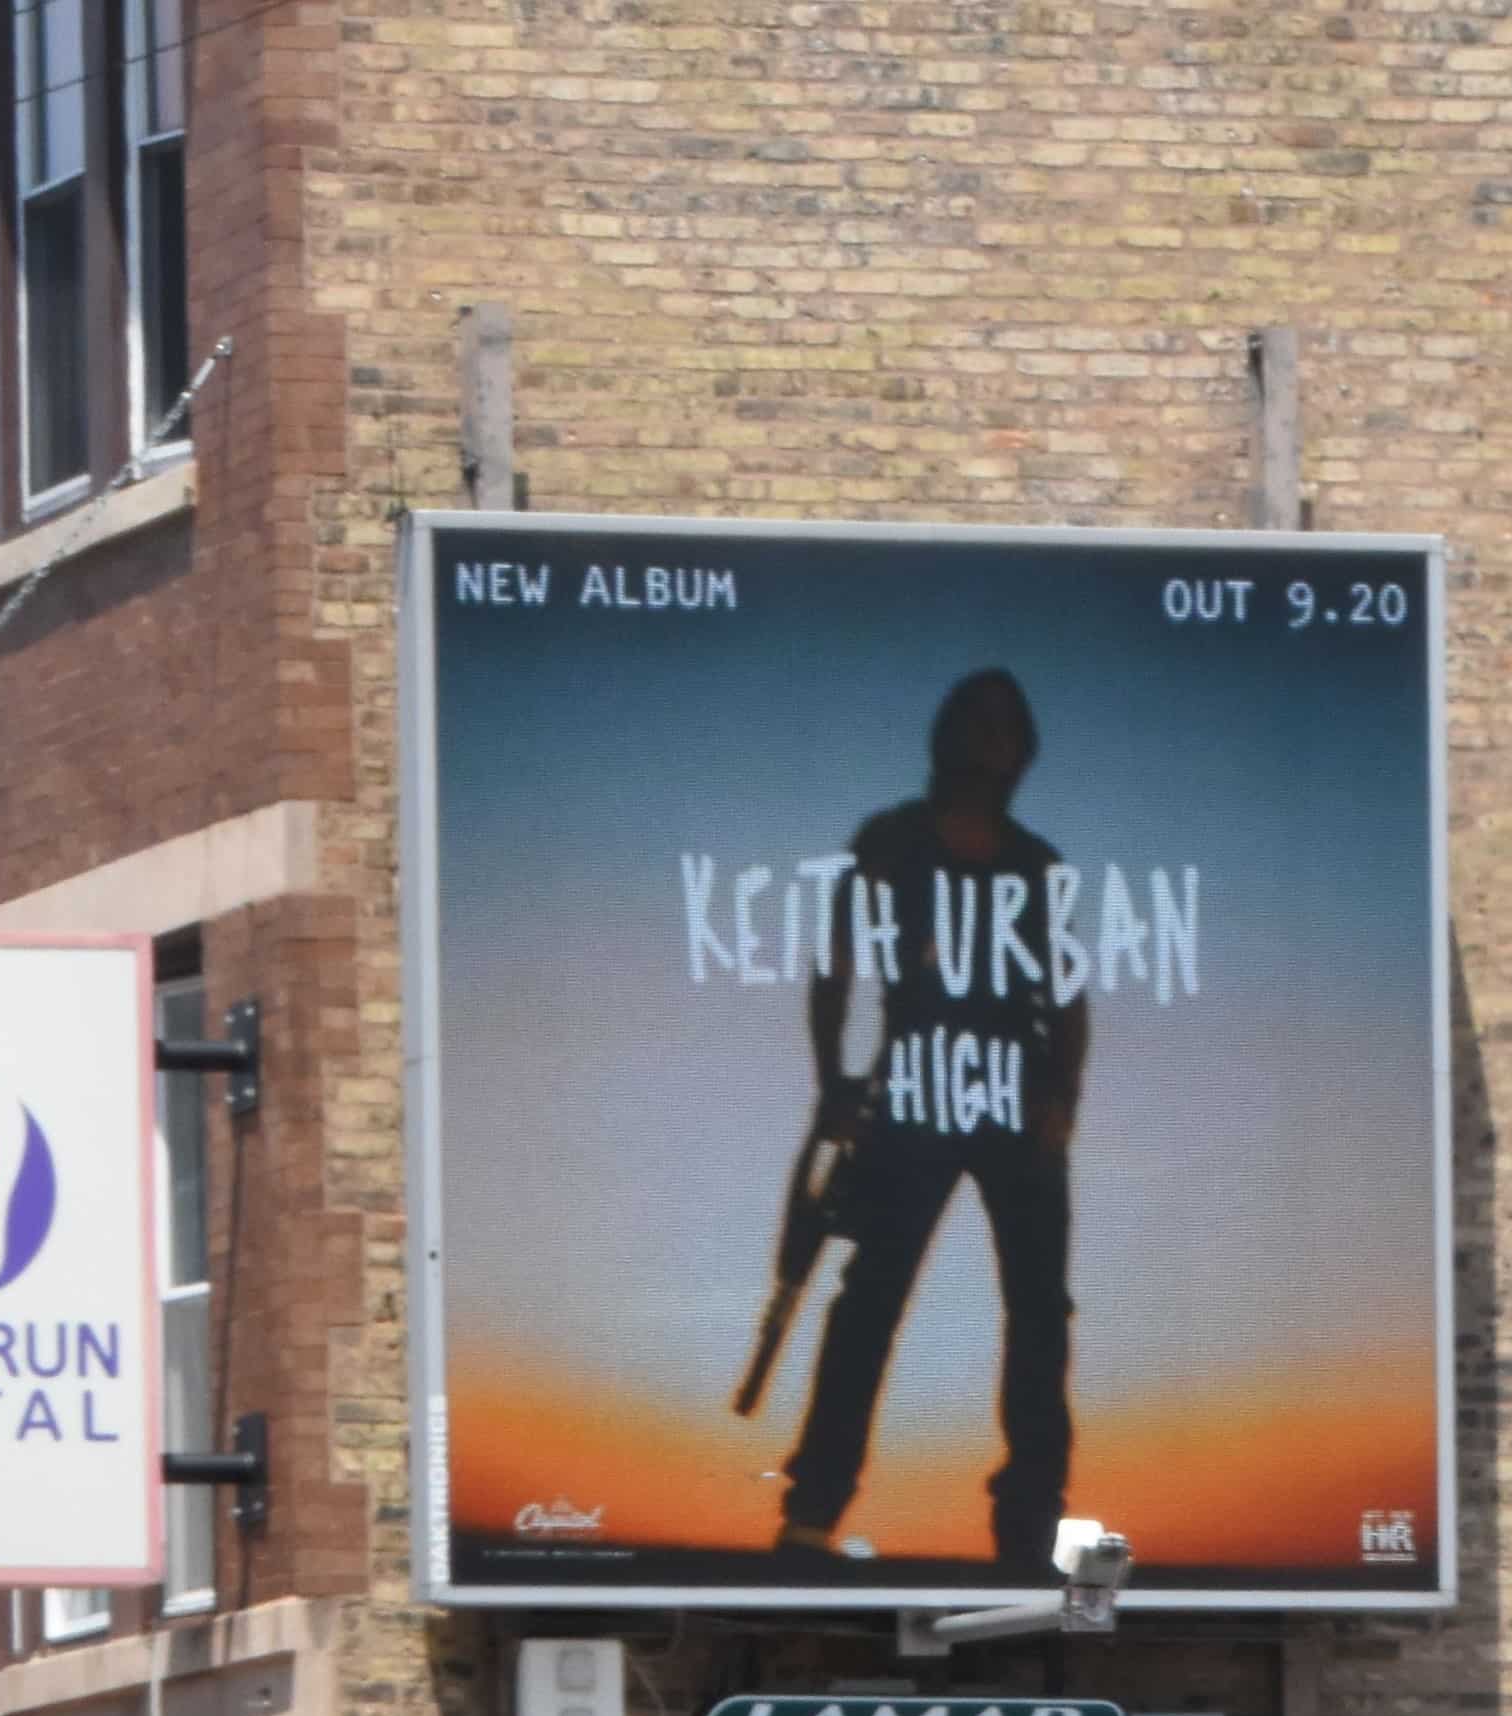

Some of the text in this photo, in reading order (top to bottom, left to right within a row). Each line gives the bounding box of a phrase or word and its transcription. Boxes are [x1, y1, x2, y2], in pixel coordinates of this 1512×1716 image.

[458, 563, 737, 610] NEW ALBUM
[1164, 580, 1407, 627] OUT 9.20
[680, 853, 1200, 1007] KEITH URBAN
[888, 1025, 1024, 1133] HIGH
